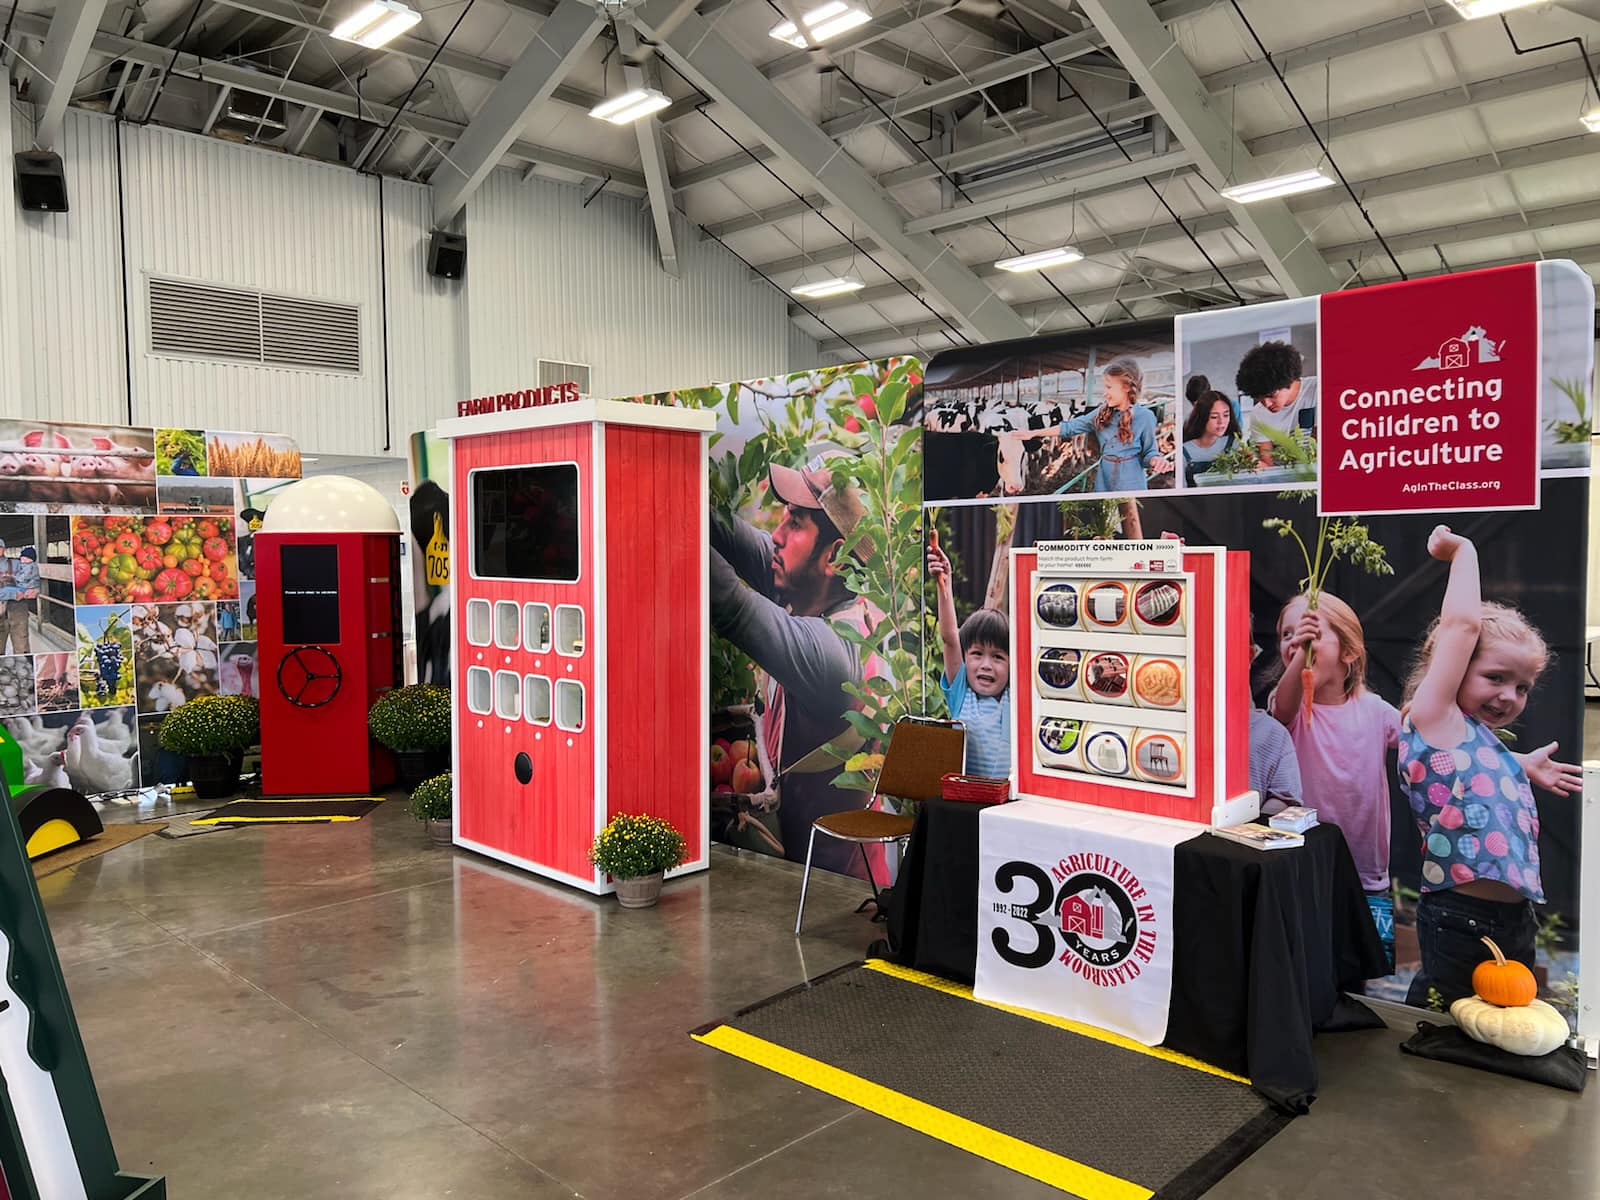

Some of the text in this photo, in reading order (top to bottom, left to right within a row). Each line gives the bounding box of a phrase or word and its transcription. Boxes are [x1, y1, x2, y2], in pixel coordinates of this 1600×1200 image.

[457, 381, 579, 417] FARM PRODUCTS
[1340, 377, 1502, 410] Connecting
[1341, 407, 1500, 440] Children to
[1339, 443, 1503, 474] Agriculture
[1402, 480, 1501, 494] AgInTheClass.org
[1038, 543, 1153, 552] COMMODITY CONNECTION
[1051, 852, 1157, 987] AGRICULTURE IN THE CLASSROOM
[1075, 940, 1120, 963] YEARS
